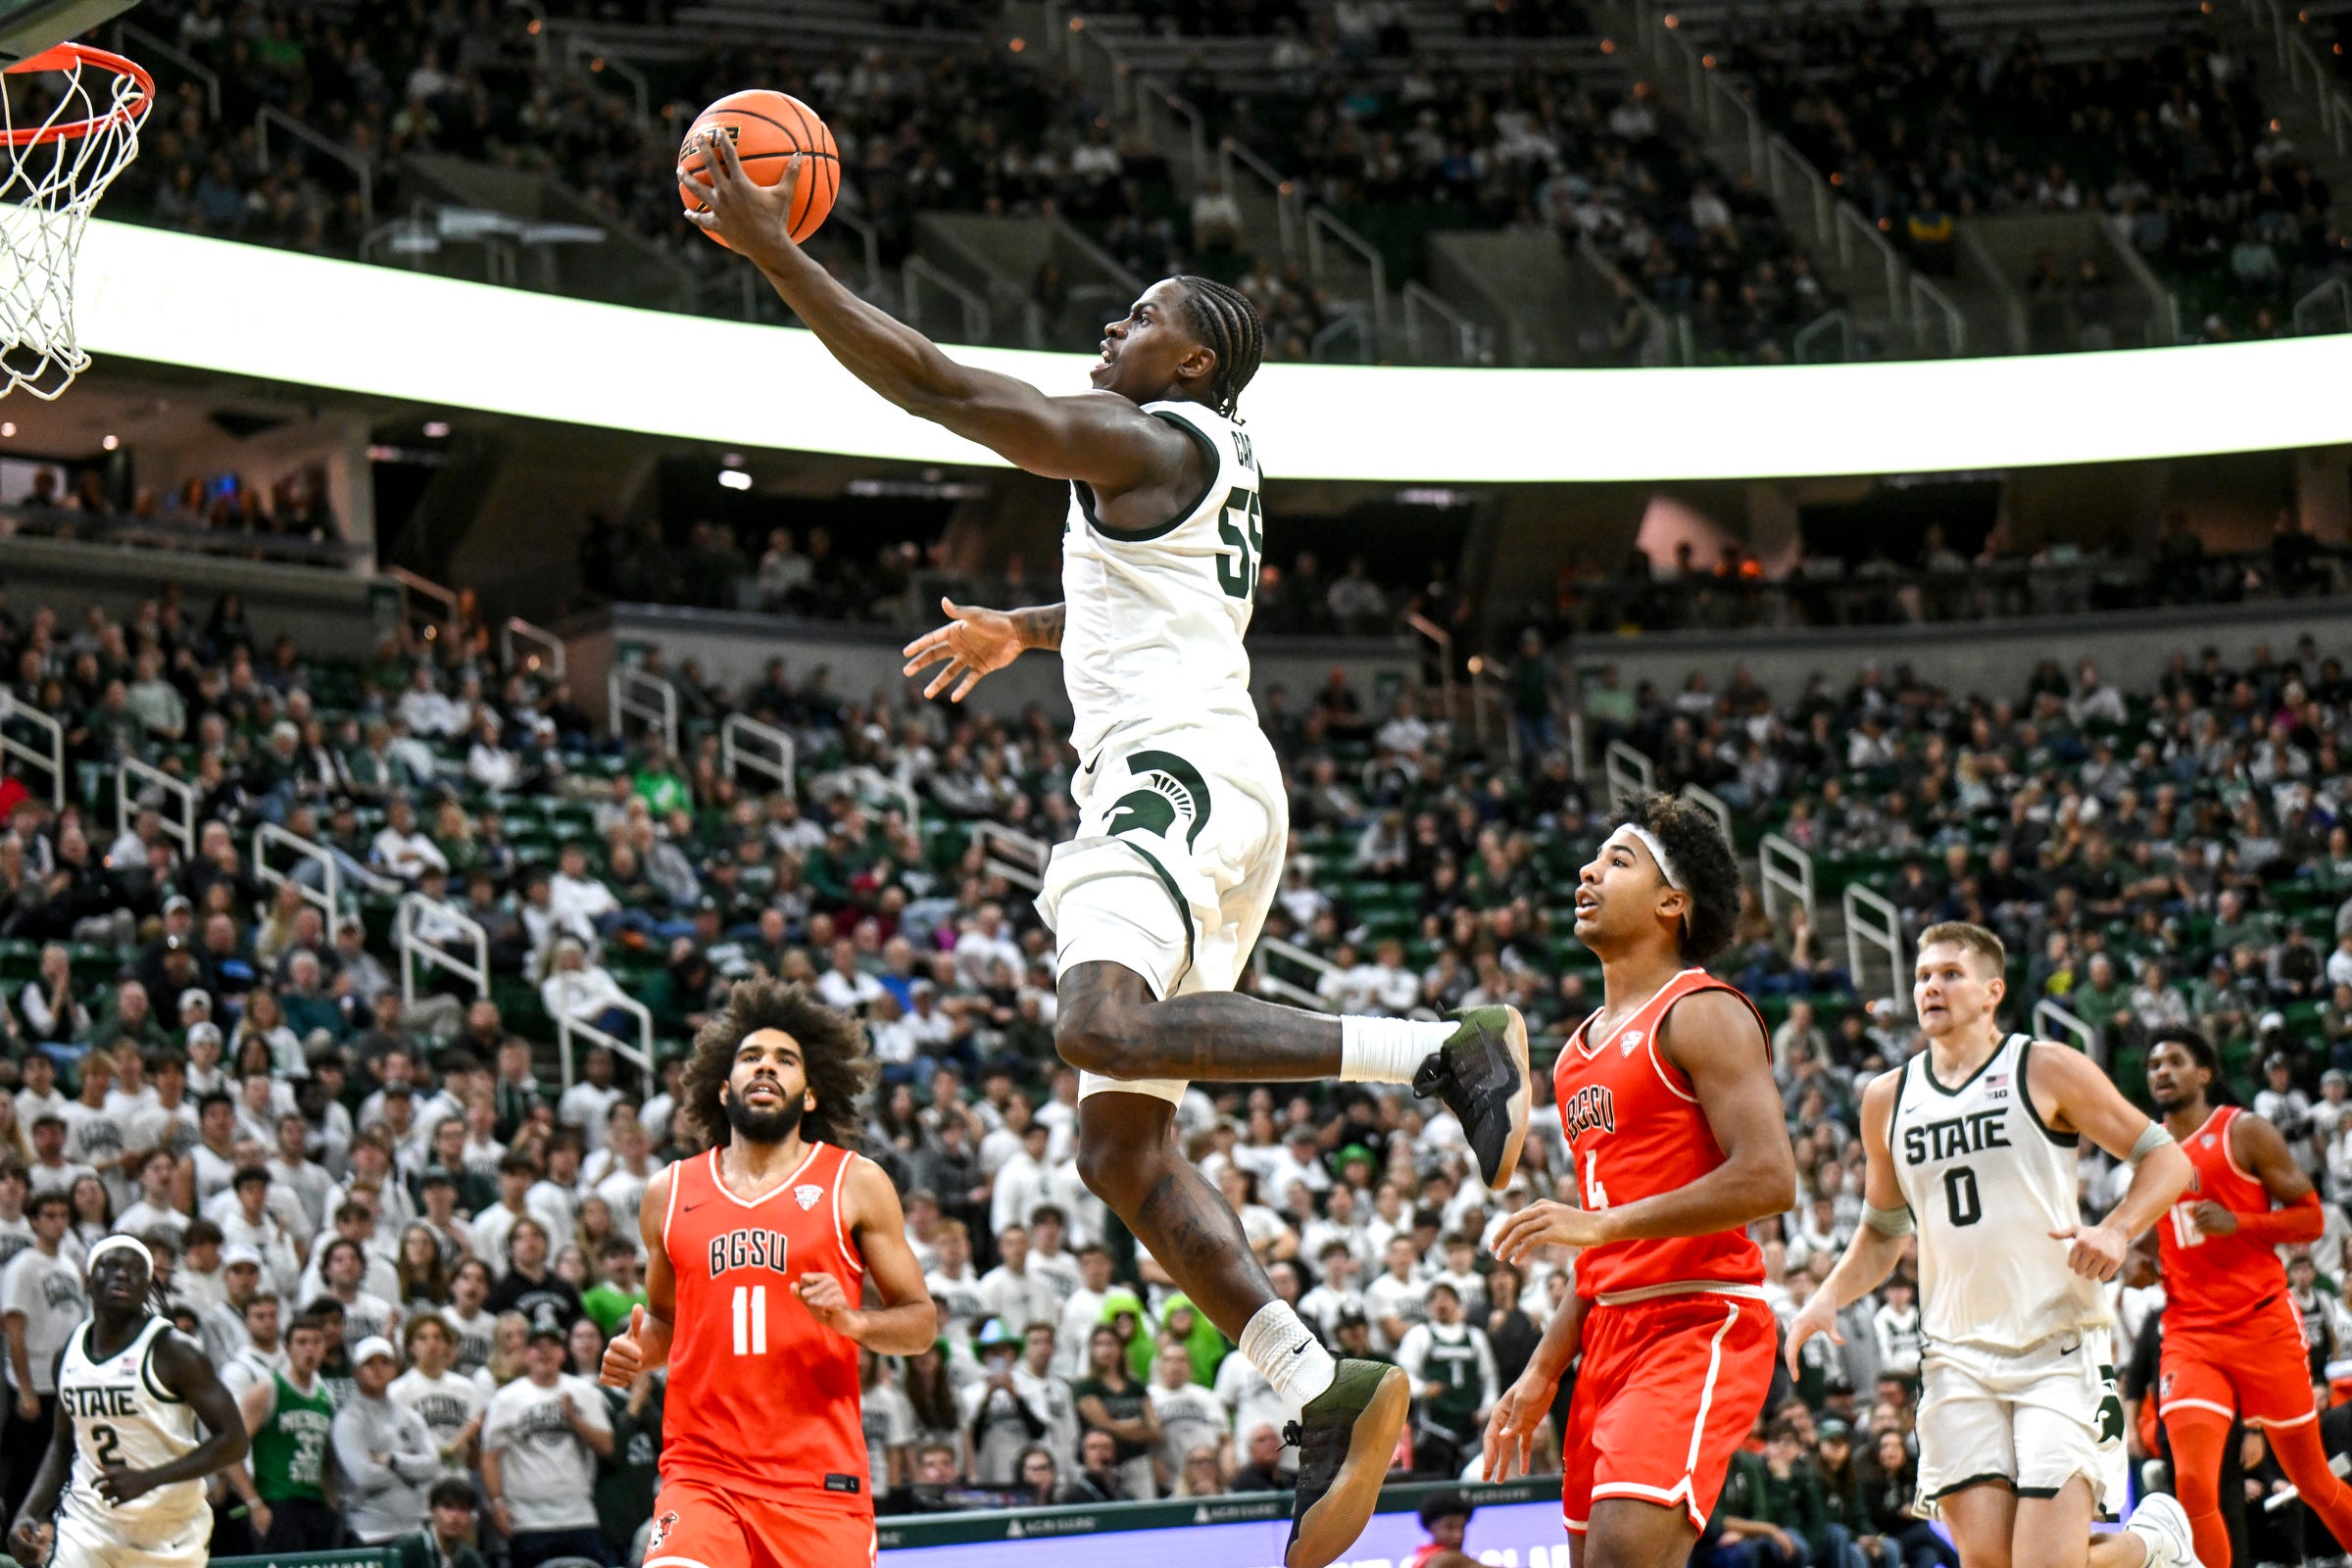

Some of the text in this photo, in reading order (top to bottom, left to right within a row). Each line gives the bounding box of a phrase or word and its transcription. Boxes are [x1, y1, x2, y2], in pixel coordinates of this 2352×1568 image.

[1566, 1084, 1615, 1145] BGSU
[1903, 1106, 2012, 1166] STATE
[1585, 1149, 1610, 1211] 4
[1943, 1165, 1983, 1228] 0
[710, 1227, 788, 1280] BGSU
[731, 1285, 767, 1355] 11
[63, 1385, 139, 1417] STATE
[90, 1424, 126, 1468] 2
